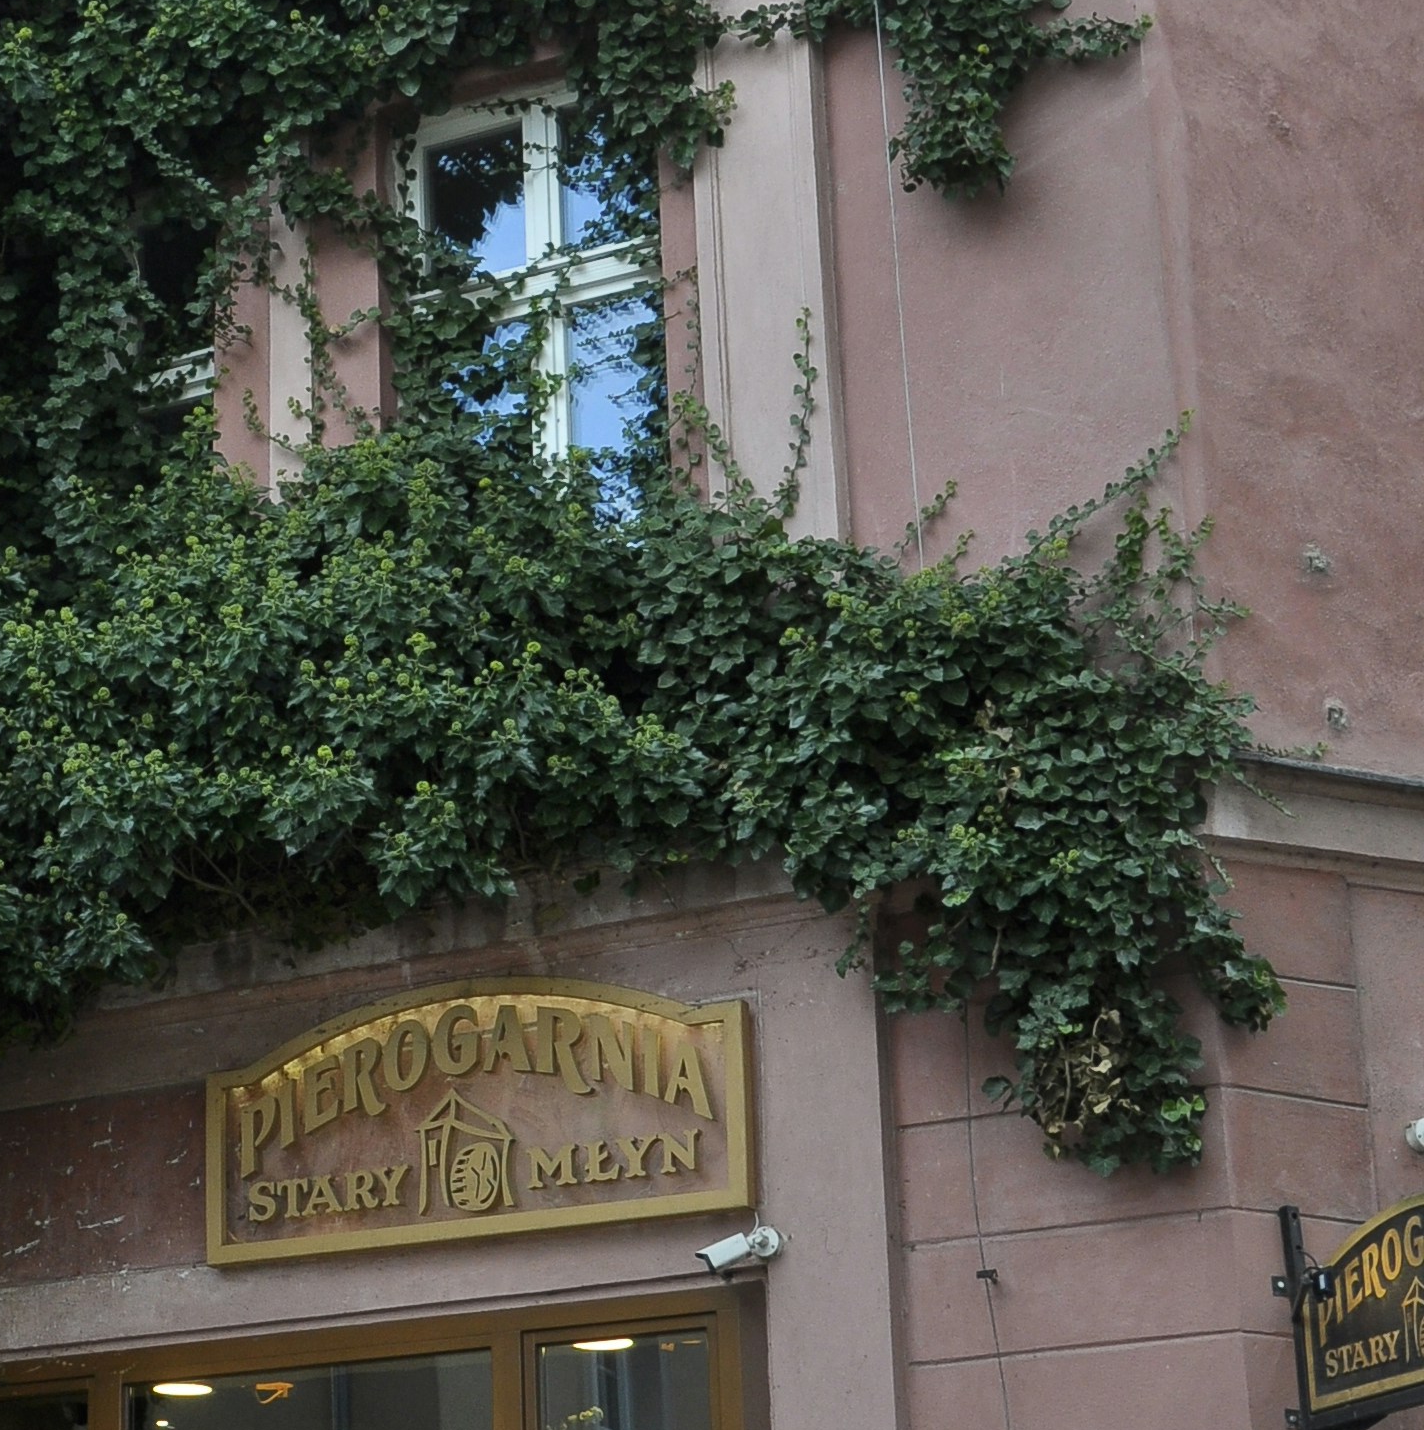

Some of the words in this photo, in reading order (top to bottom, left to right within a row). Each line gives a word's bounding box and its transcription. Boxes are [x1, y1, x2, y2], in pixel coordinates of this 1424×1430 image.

[240, 1003, 717, 1180] PIEROGARNIA
[248, 1163, 410, 1222] STARY
[528, 1128, 701, 1190] MŁYN
[1325, 1330, 1400, 1377] STARY
